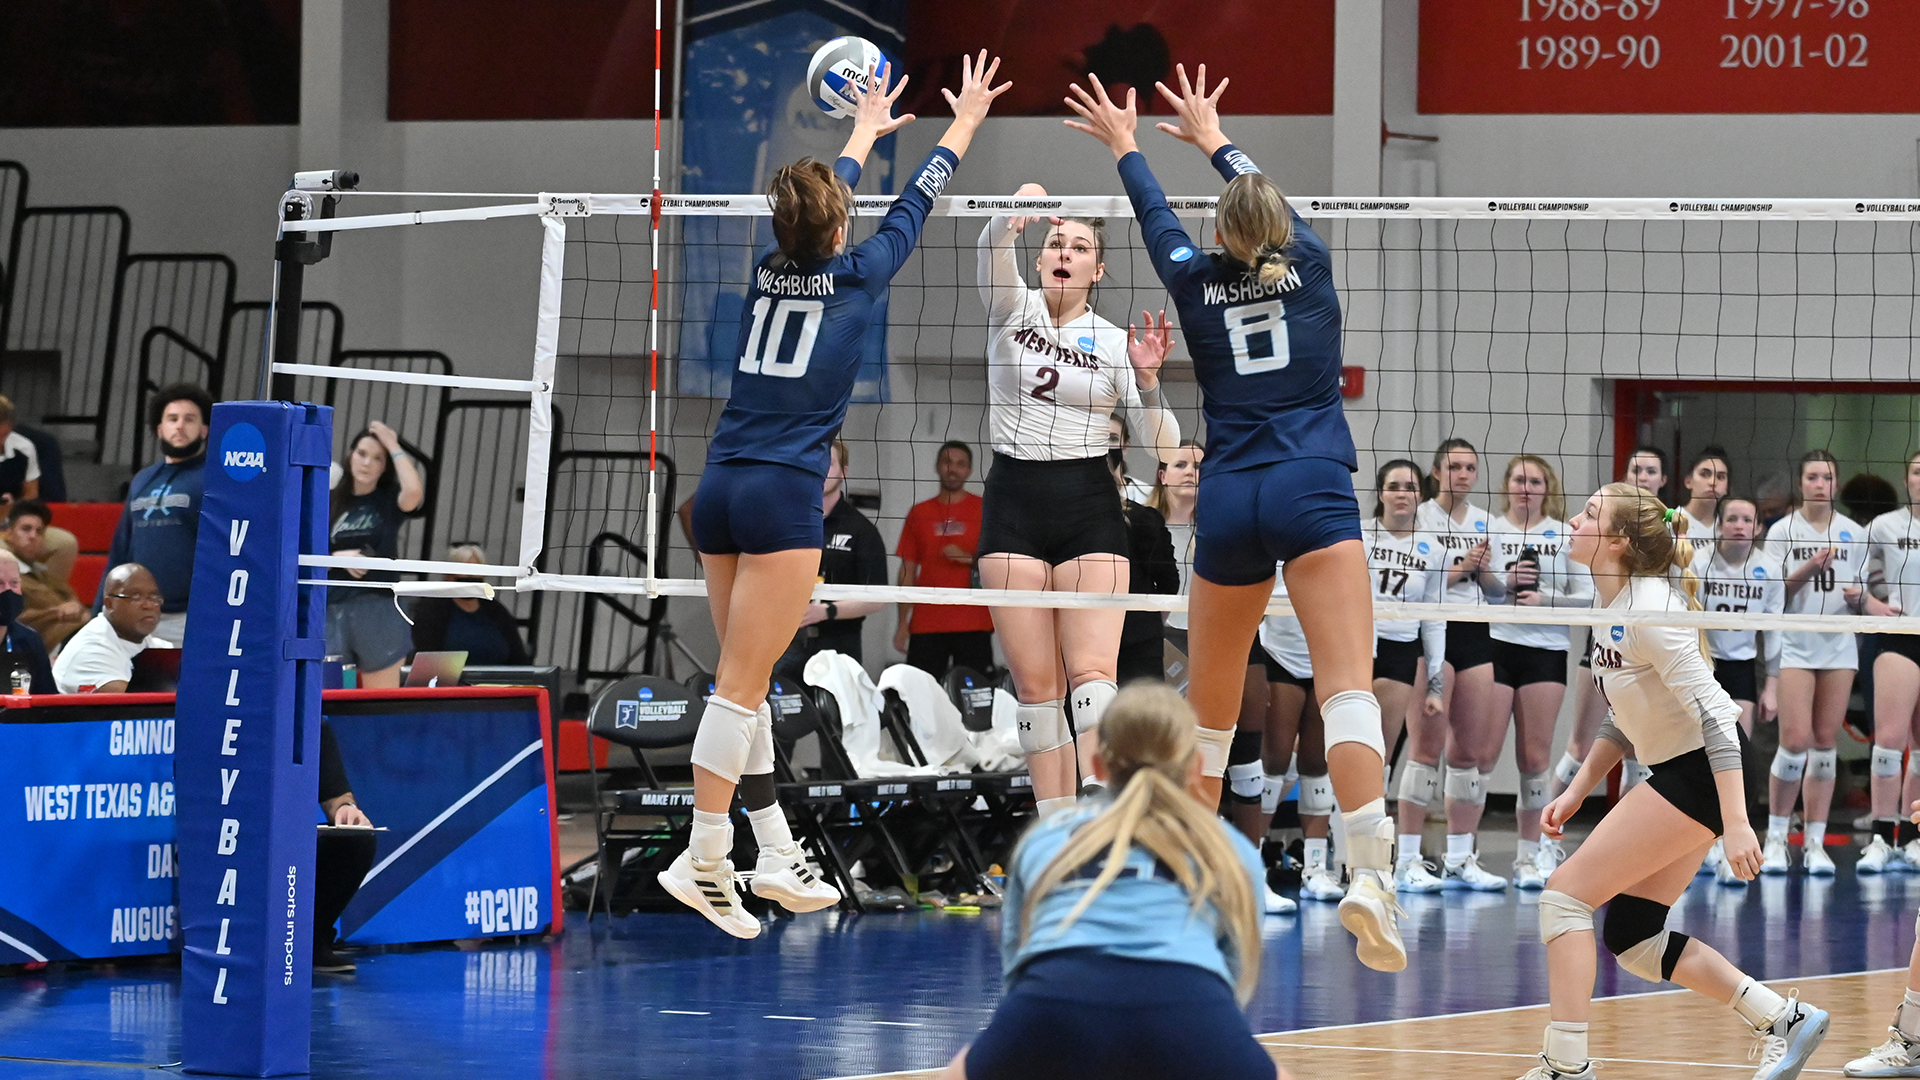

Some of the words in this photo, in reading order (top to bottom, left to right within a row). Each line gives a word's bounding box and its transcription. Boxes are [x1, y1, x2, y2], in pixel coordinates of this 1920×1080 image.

[1519, 0, 1661, 22] 1988-89
[1516, 34, 1661, 70] 1989-90
[1719, 33, 1869, 69] 2001-02
[684, 200, 730, 208] CHAMPIONSHIP
[977, 201, 1013, 209] VOLLEYBALL
[1014, 201, 1062, 209] CHAMPIONSHIP
[1321, 202, 1359, 210] VOLLEYBALL
[1360, 202, 1410, 210] CHAMPIONSHIP
[1498, 203, 1537, 211] VOLLEYBALL
[1538, 203, 1589, 211] CHAMPIONSHIP
[1680, 203, 1719, 212] VOLLEYBALL
[1720, 203, 1773, 212] CHAMPIONSHIP
[1866, 204, 1905, 212] VOLLEYBALL
[756, 266, 835, 296] WASHBURN
[1202, 265, 1302, 306] WASHBURN
[738, 296, 825, 378] 10
[1013, 327, 1055, 357] WEST
[1055, 345, 1100, 371] TEXAS
[1223, 299, 1291, 376] 8
[1031, 366, 1060, 403] 2
[224, 450, 264, 468] NCAA
[1897, 537, 1920, 550] WES
[1379, 567, 1409, 597] 17
[1703, 581, 1730, 597] WEST
[1733, 584, 1763, 600] TEXAS
[1813, 567, 1835, 593] 10
[109, 720, 175, 756] GANNO
[213, 519, 249, 1004] VOLLEYBALL
[24, 784, 81, 822] WEST
[85, 782, 142, 819] TEXAS
[146, 781, 176, 817] A&
[641, 794, 669, 806] MAKE
[669, 794, 680, 805] IT
[147, 843, 179, 879] DA
[286, 865, 297, 918] sports
[110, 905, 178, 943] AUGUS
[465, 886, 539, 934] #D2VB
